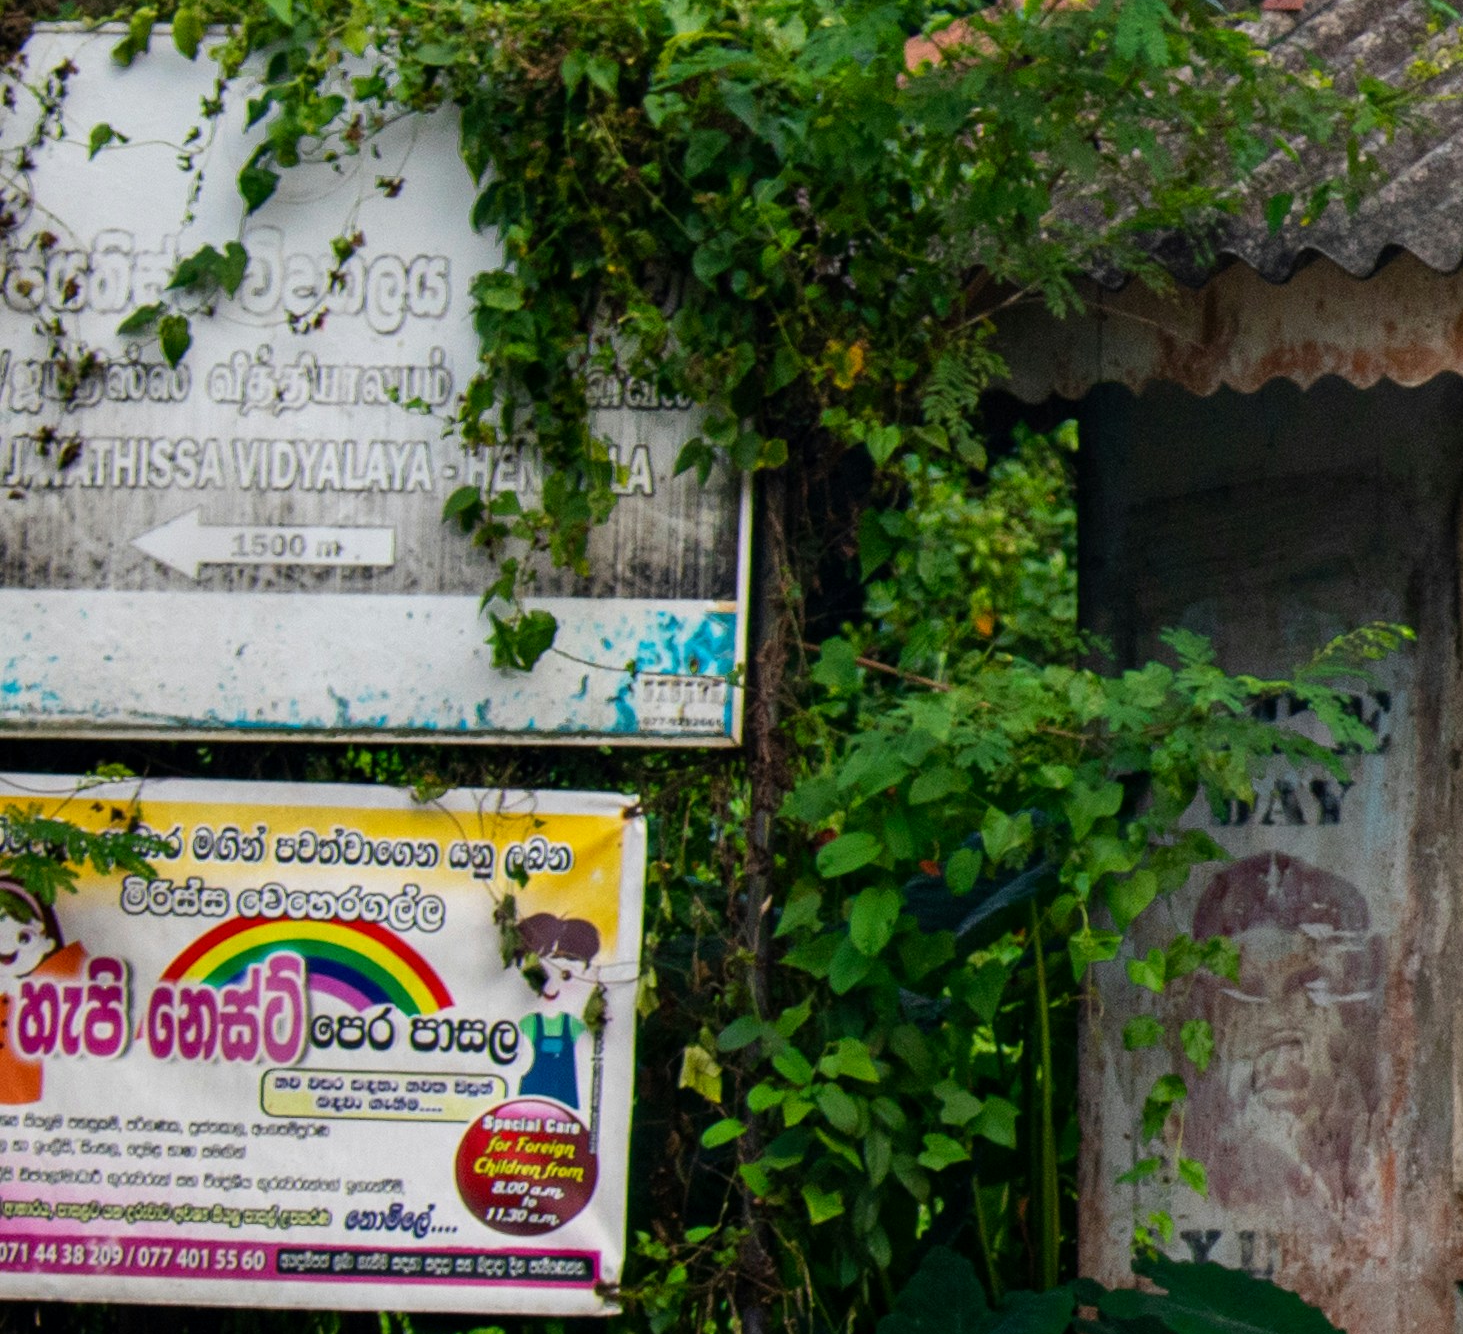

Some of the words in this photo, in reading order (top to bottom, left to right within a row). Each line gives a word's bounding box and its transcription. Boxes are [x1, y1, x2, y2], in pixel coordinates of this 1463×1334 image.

[232, 437, 432, 493] VIDYALAYA
[231, 533, 306, 557] 1500
[193, 825, 266, 862] මගින්
[275, 827, 439, 867] පවත්වාගෙන
[449, 842, 495, 880] යනු
[505, 837, 573, 880] ලබන
[121, 875, 230, 917] මිරිස්ස
[236, 882, 447, 934] වෙහෙරගල්ල
[311, 1006, 394, 1051] පෙර
[409, 1017, 520, 1065] පාසල
[482, 1114, 542, 1134] Special
[545, 1118, 582, 1135] Care
[485, 1136, 514, 1154] for
[515, 1136, 577, 1160] Foreign
[473, 1155, 542, 1181] Children
[541, 1161, 585, 1183] from
[490, 1180, 530, 1195] 8.00
[485, 1206, 529, 1223] 11.30
[521, 1194, 538, 1209] to
[34, 1242, 58, 1265] 44
[60, 1243, 86, 1266] 38
[87, 1244, 124, 1267] 209
[137, 1245, 174, 1268] 077
[176, 1247, 210, 1270] 401
[213, 1248, 239, 1270] 55
[241, 1249, 267, 1271] 60
